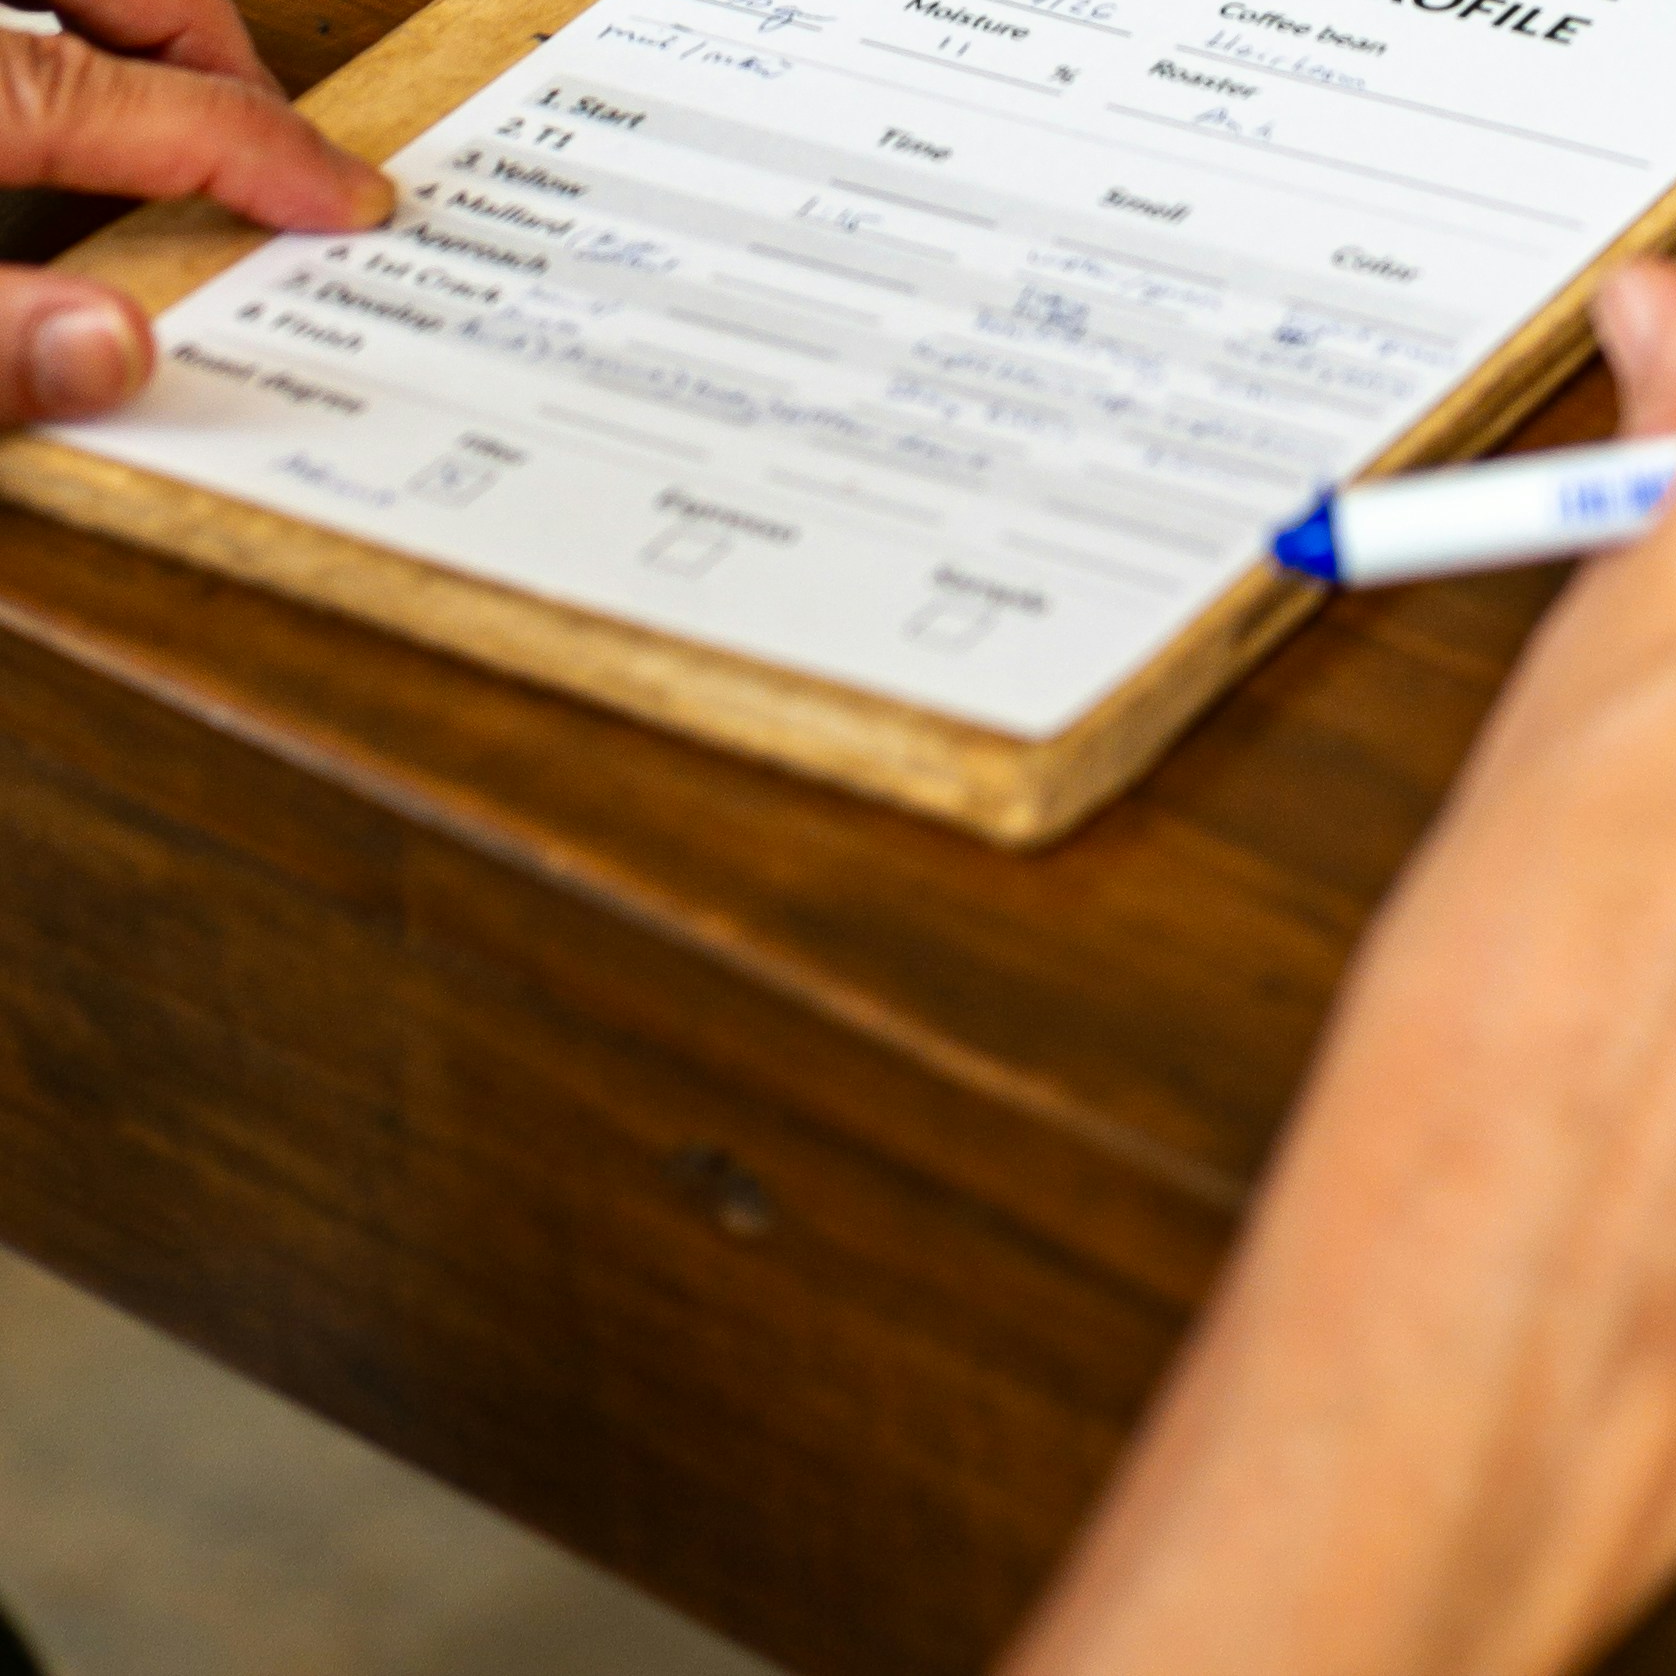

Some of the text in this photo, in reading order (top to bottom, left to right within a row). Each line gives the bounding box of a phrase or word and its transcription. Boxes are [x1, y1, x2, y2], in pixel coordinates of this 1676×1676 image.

[1218, 0, 1389, 56] Coffee bean
[569, 95, 650, 129] Start
